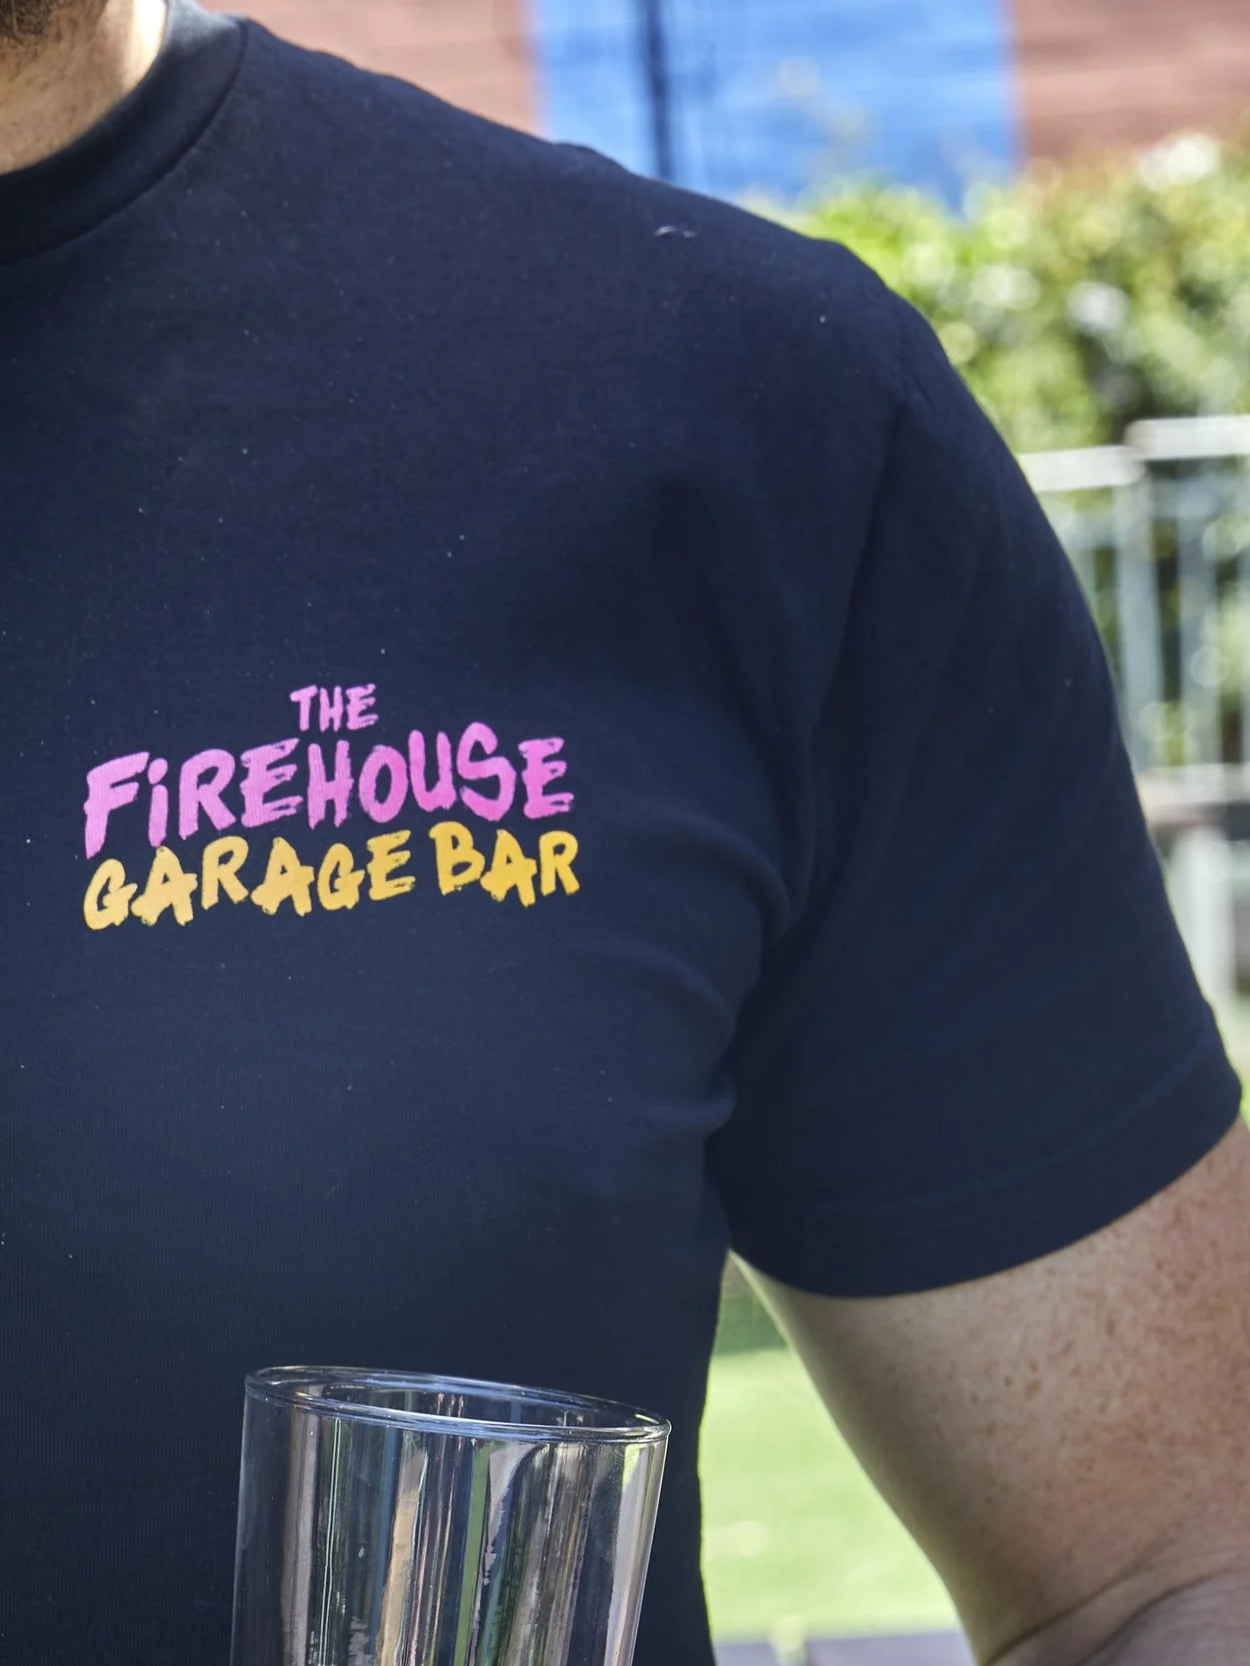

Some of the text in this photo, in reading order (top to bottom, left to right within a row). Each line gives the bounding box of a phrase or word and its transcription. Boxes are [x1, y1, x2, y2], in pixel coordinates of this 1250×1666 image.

[290, 683, 378, 732] THE
[83, 821, 580, 930] GARAGE BAR
